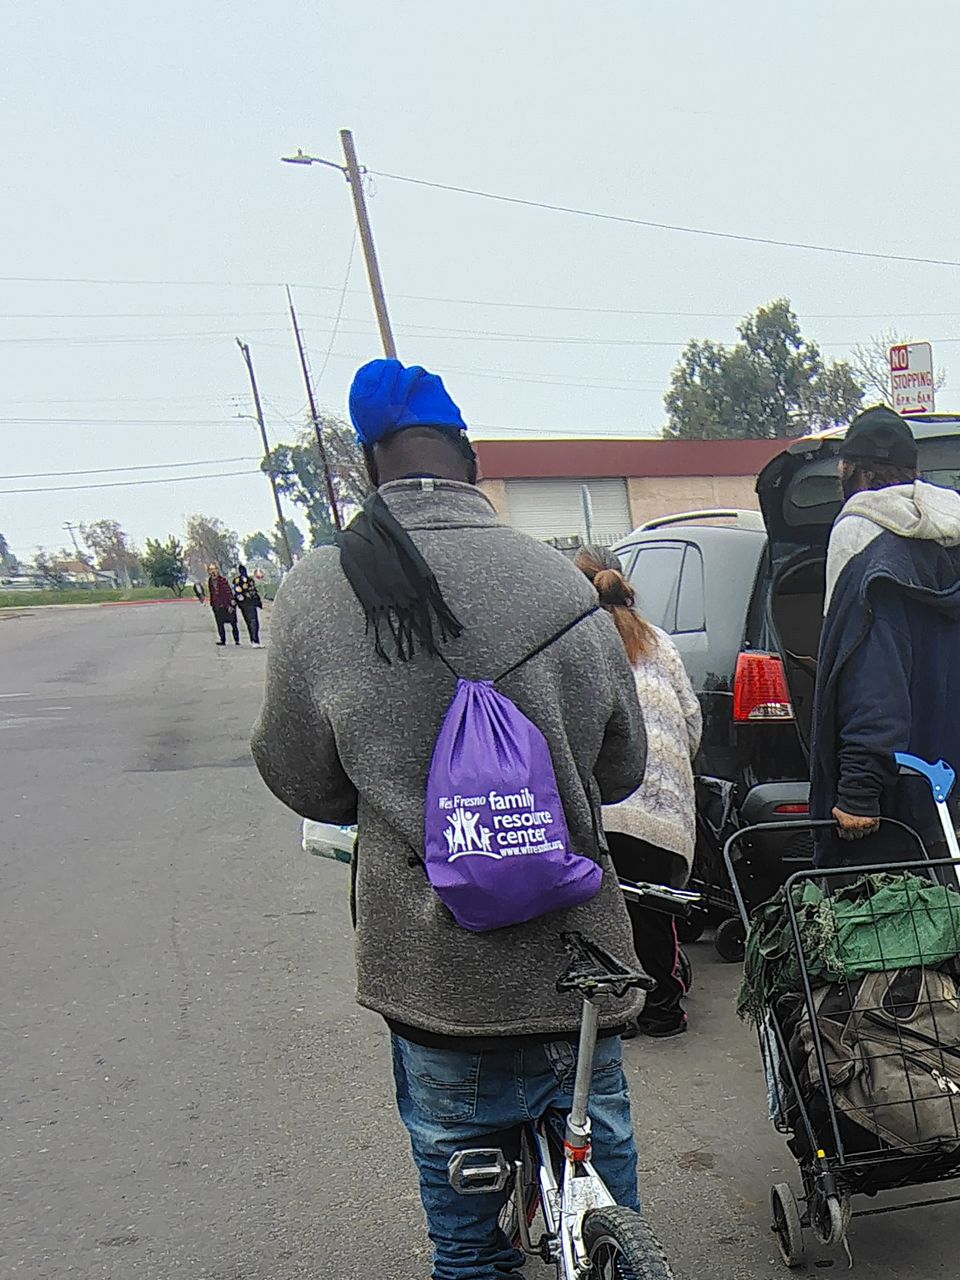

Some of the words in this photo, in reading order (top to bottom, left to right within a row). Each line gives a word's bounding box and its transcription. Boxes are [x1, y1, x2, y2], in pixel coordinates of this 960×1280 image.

[892, 349, 907, 368] NO
[894, 371, 932, 389] STOPPING
[453, 795, 486, 808] Fresno
[488, 788, 534, 811] family
[493, 811, 553, 829] resource
[497, 828, 546, 845] center
